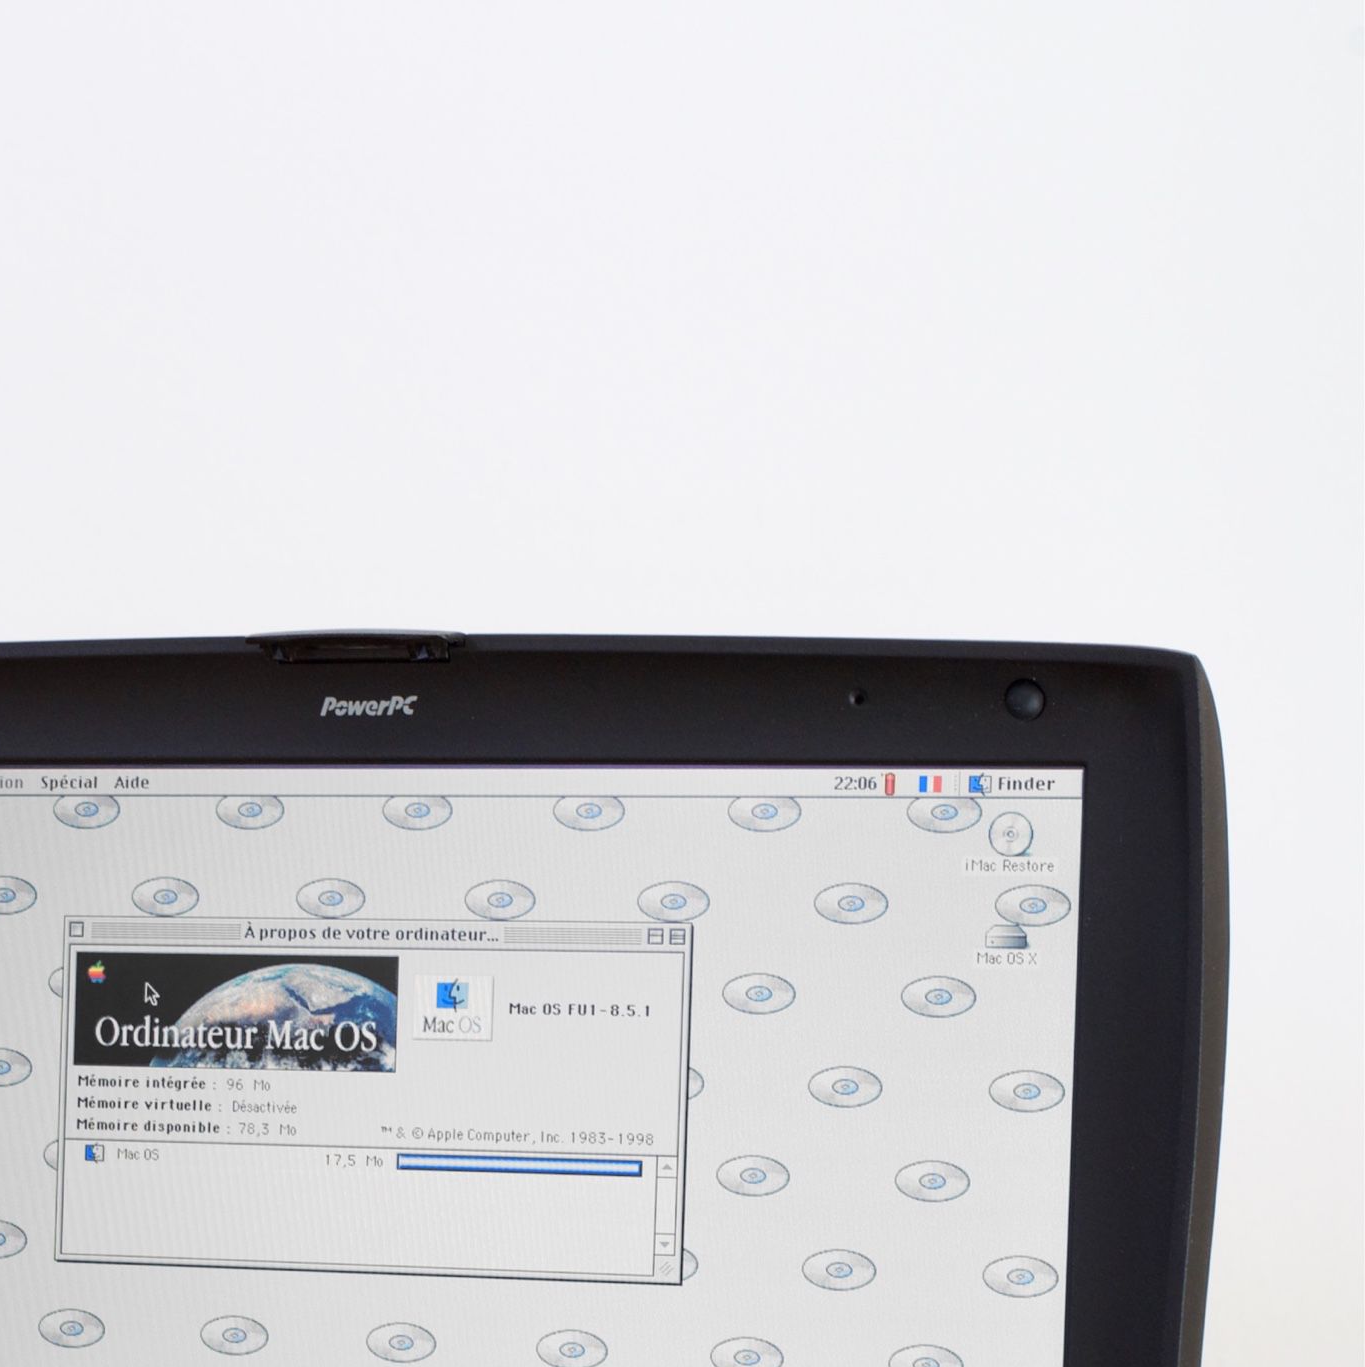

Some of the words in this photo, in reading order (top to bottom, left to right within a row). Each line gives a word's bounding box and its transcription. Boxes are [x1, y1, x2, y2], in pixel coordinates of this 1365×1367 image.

[320, 695, 418, 717] PowerPC
[41, 775, 98, 793] Spécial
[114, 776, 149, 790] Aide
[834, 776, 877, 792] 22:06
[997, 776, 1055, 792] Finder
[1002, 859, 1054, 872] Restore
[245, 924, 257, 941] À
[260, 927, 317, 946] propos
[322, 925, 341, 942] de
[345, 927, 392, 942] votre
[977, 952, 1003, 966] Mac
[1007, 952, 1023, 966] OS
[509, 1002, 538, 1016] Mac
[543, 1002, 562, 1016] OS
[422, 1015, 454, 1035] Mac
[458, 1017, 482, 1036] OS
[95, 1018, 258, 1052] Ordinateur
[265, 1019, 325, 1051] Mac
[333, 1021, 378, 1053] OS
[77, 1074, 139, 1090] Mémoire
[226, 1078, 245, 1092] 96
[253, 1078, 271, 1092] Mo
[77, 1097, 139, 1112] Mémoire
[232, 1100, 298, 1114] Désactivée
[76, 1118, 139, 1133] Mémoire
[237, 1122, 270, 1138] 78,3
[278, 1123, 297, 1137] Mo
[427, 1128, 463, 1145] Apple
[570, 1130, 654, 1146] 1983-1998
[117, 1148, 140, 1160] Mac
[145, 1149, 160, 1161] OS
[325, 1155, 356, 1170] 17,5
[366, 1156, 384, 1168] Mo
